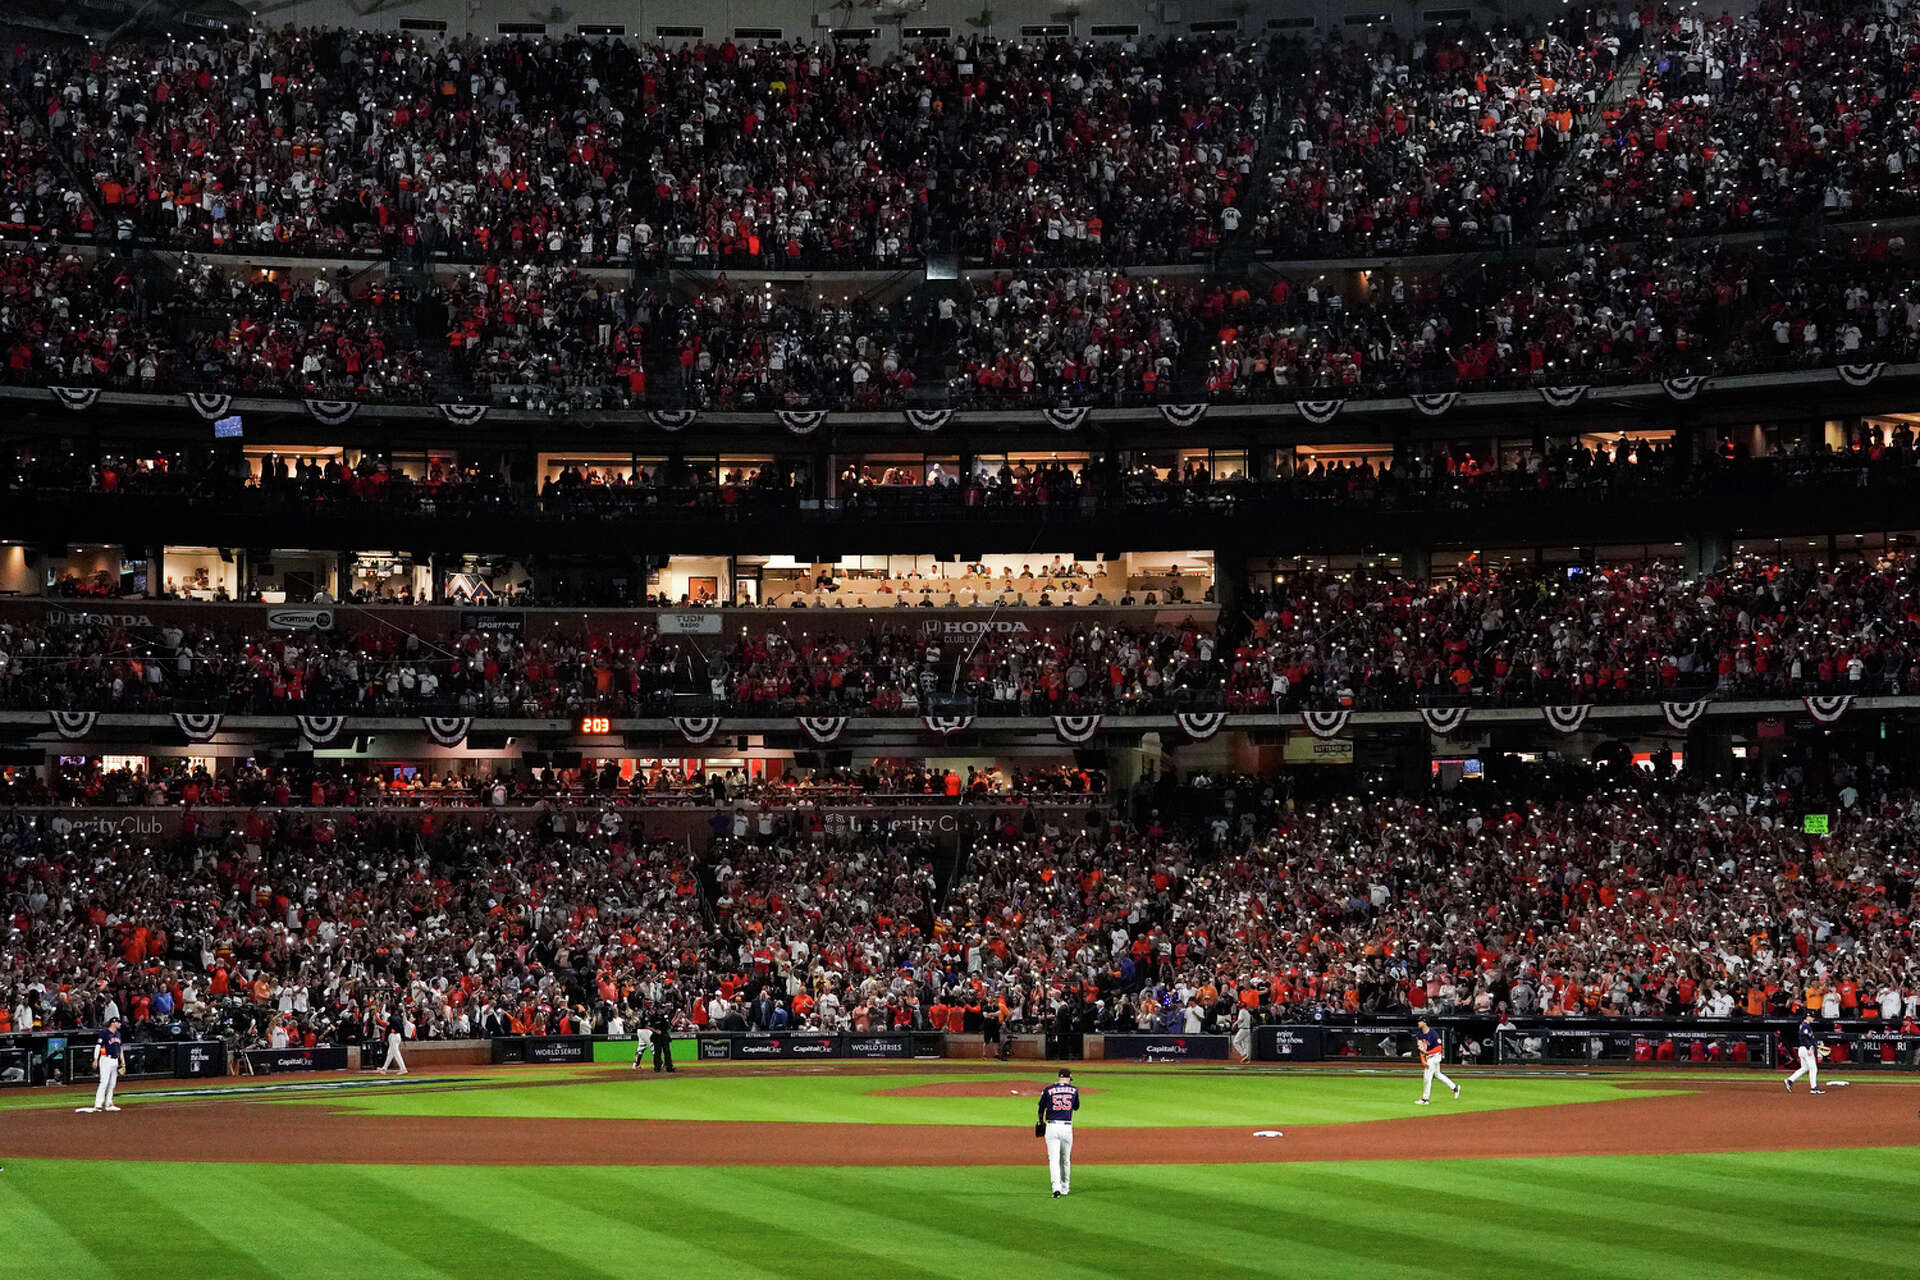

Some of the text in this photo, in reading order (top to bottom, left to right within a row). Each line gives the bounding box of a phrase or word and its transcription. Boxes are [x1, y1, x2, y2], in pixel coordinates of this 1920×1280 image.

[69, 613, 153, 627] HONDA
[943, 621, 1030, 633] HONDA
[120, 815, 163, 834] Club
[534, 1047, 582, 1056] WORLD SERIES
[851, 1043, 902, 1051] WORLD SERIES
[1052, 1094, 1072, 1111] 55
